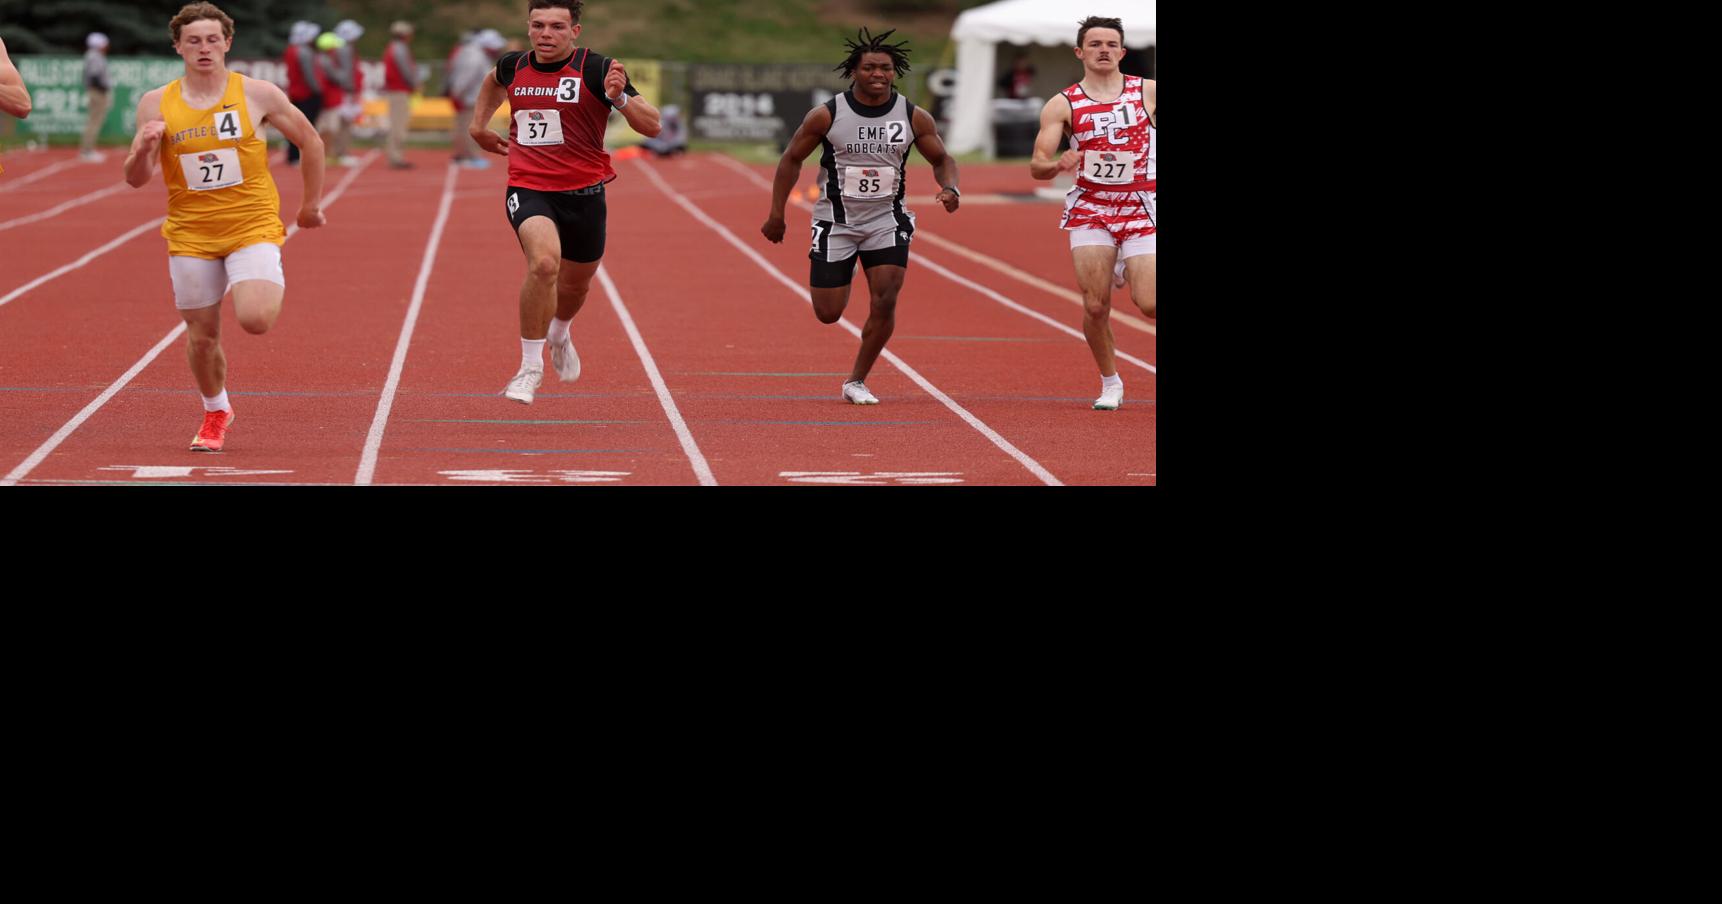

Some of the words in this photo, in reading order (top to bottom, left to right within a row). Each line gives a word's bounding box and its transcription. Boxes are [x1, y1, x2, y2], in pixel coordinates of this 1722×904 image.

[514, 87, 558, 97] CARDINA
[560, 78, 577, 101] 3
[1117, 105, 1130, 126] 1
[219, 113, 238, 136] 4
[527, 122, 549, 139] 37
[888, 122, 905, 143] 2
[858, 126, 887, 141] EMF
[846, 143, 898, 155] BOBCATS
[199, 163, 224, 183] 27
[1092, 162, 1127, 179] 227
[858, 178, 881, 193] 85
